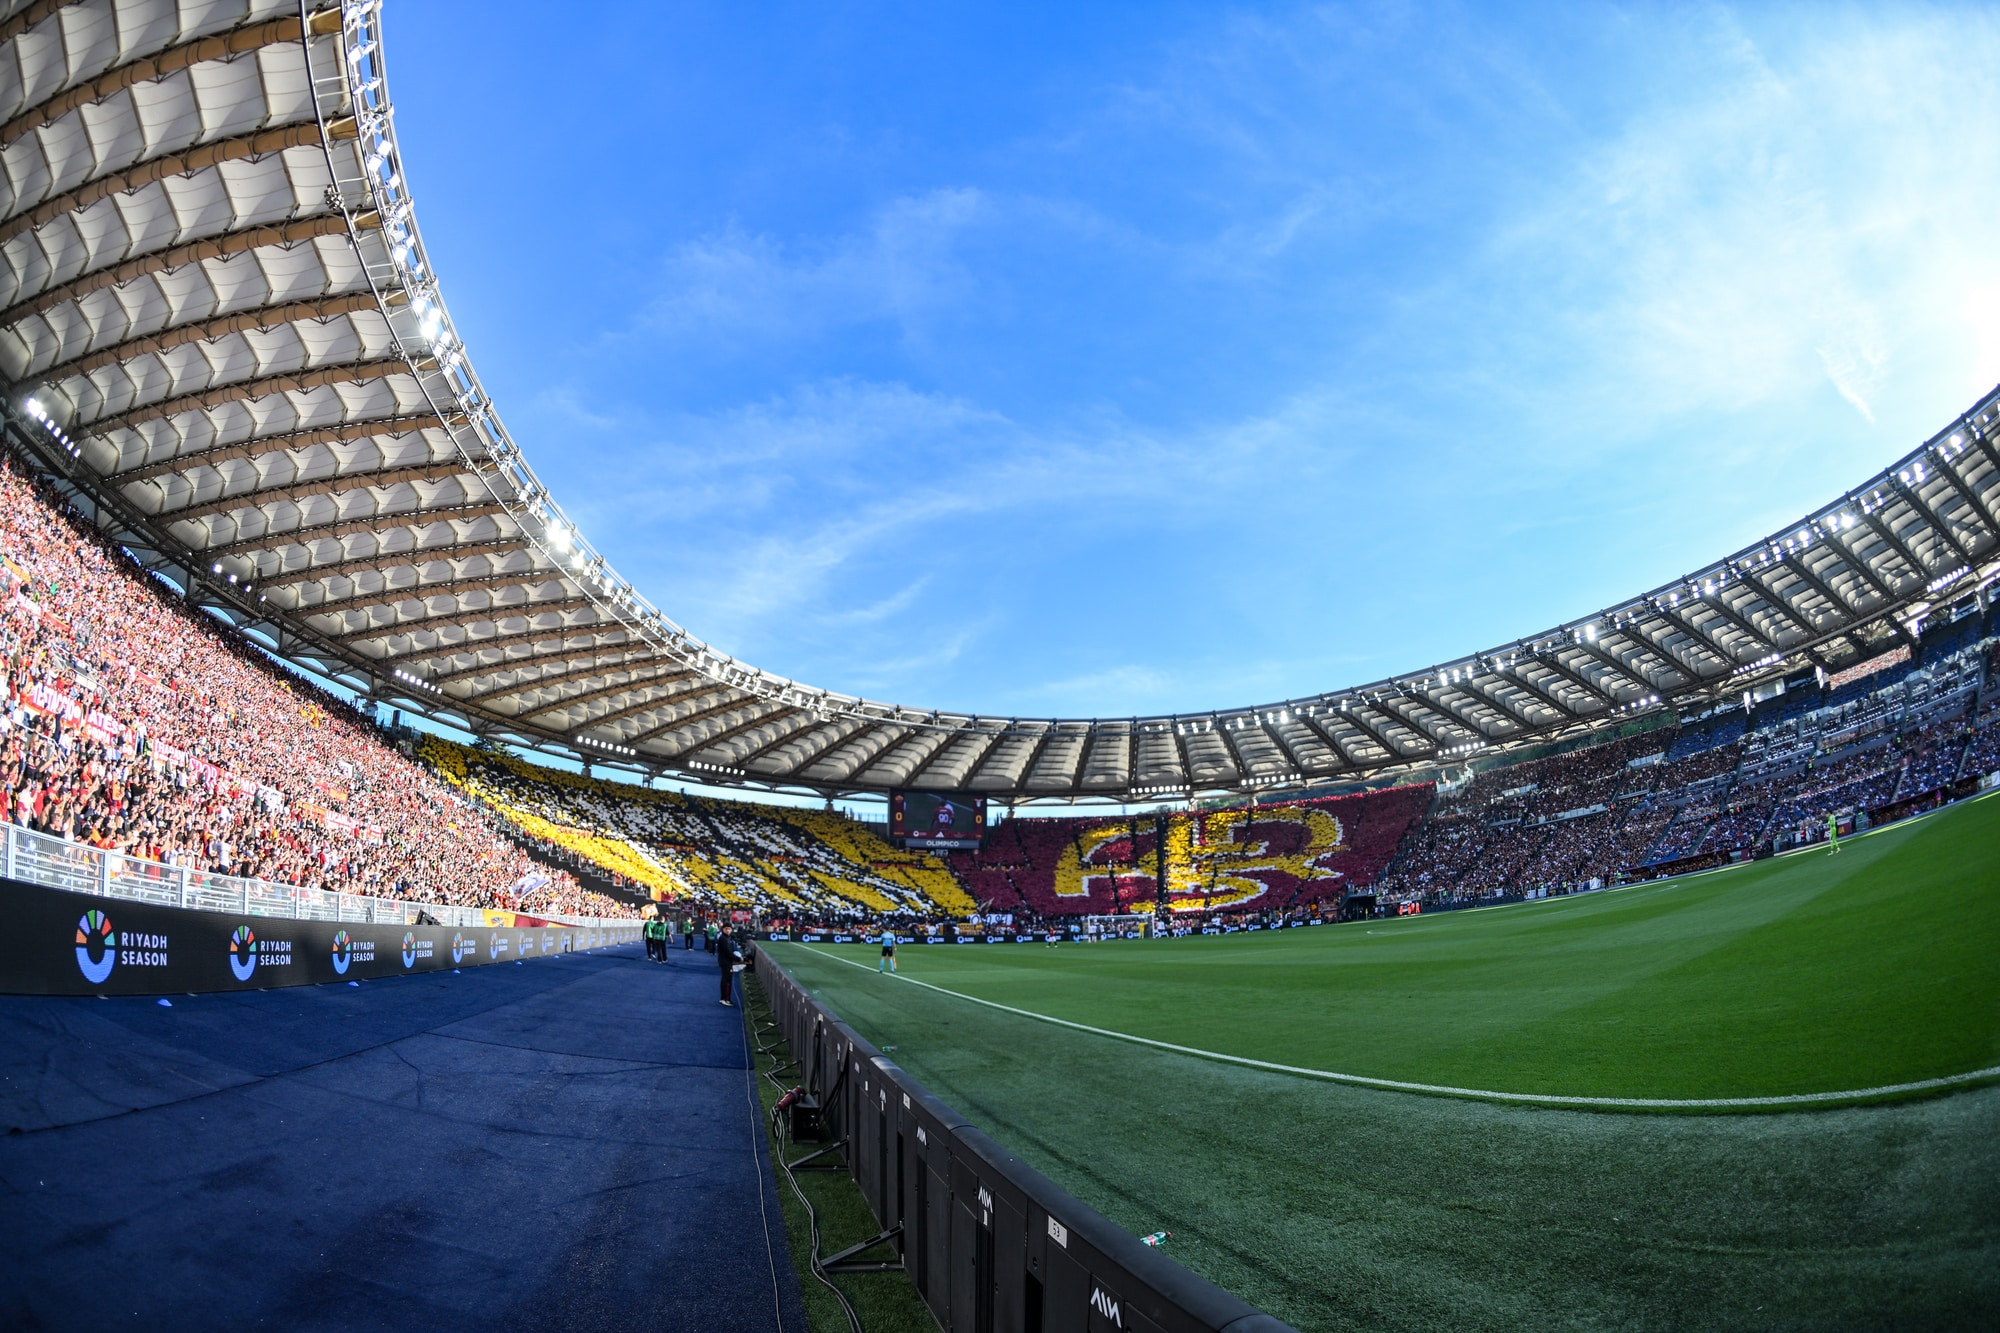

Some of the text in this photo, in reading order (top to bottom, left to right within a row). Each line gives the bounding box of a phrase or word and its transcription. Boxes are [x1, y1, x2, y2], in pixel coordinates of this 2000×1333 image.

[895, 812, 902, 821] 0
[975, 815, 982, 824] 0
[121, 931, 168, 949] RIYADH
[260, 940, 292, 952] RIYADH
[352, 941, 375, 950] RIYADH
[121, 950, 168, 966] SEASON
[352, 952, 375, 962] SEASON
[417, 950, 433, 958] SEASON
[260, 953, 292, 966] SEASON
